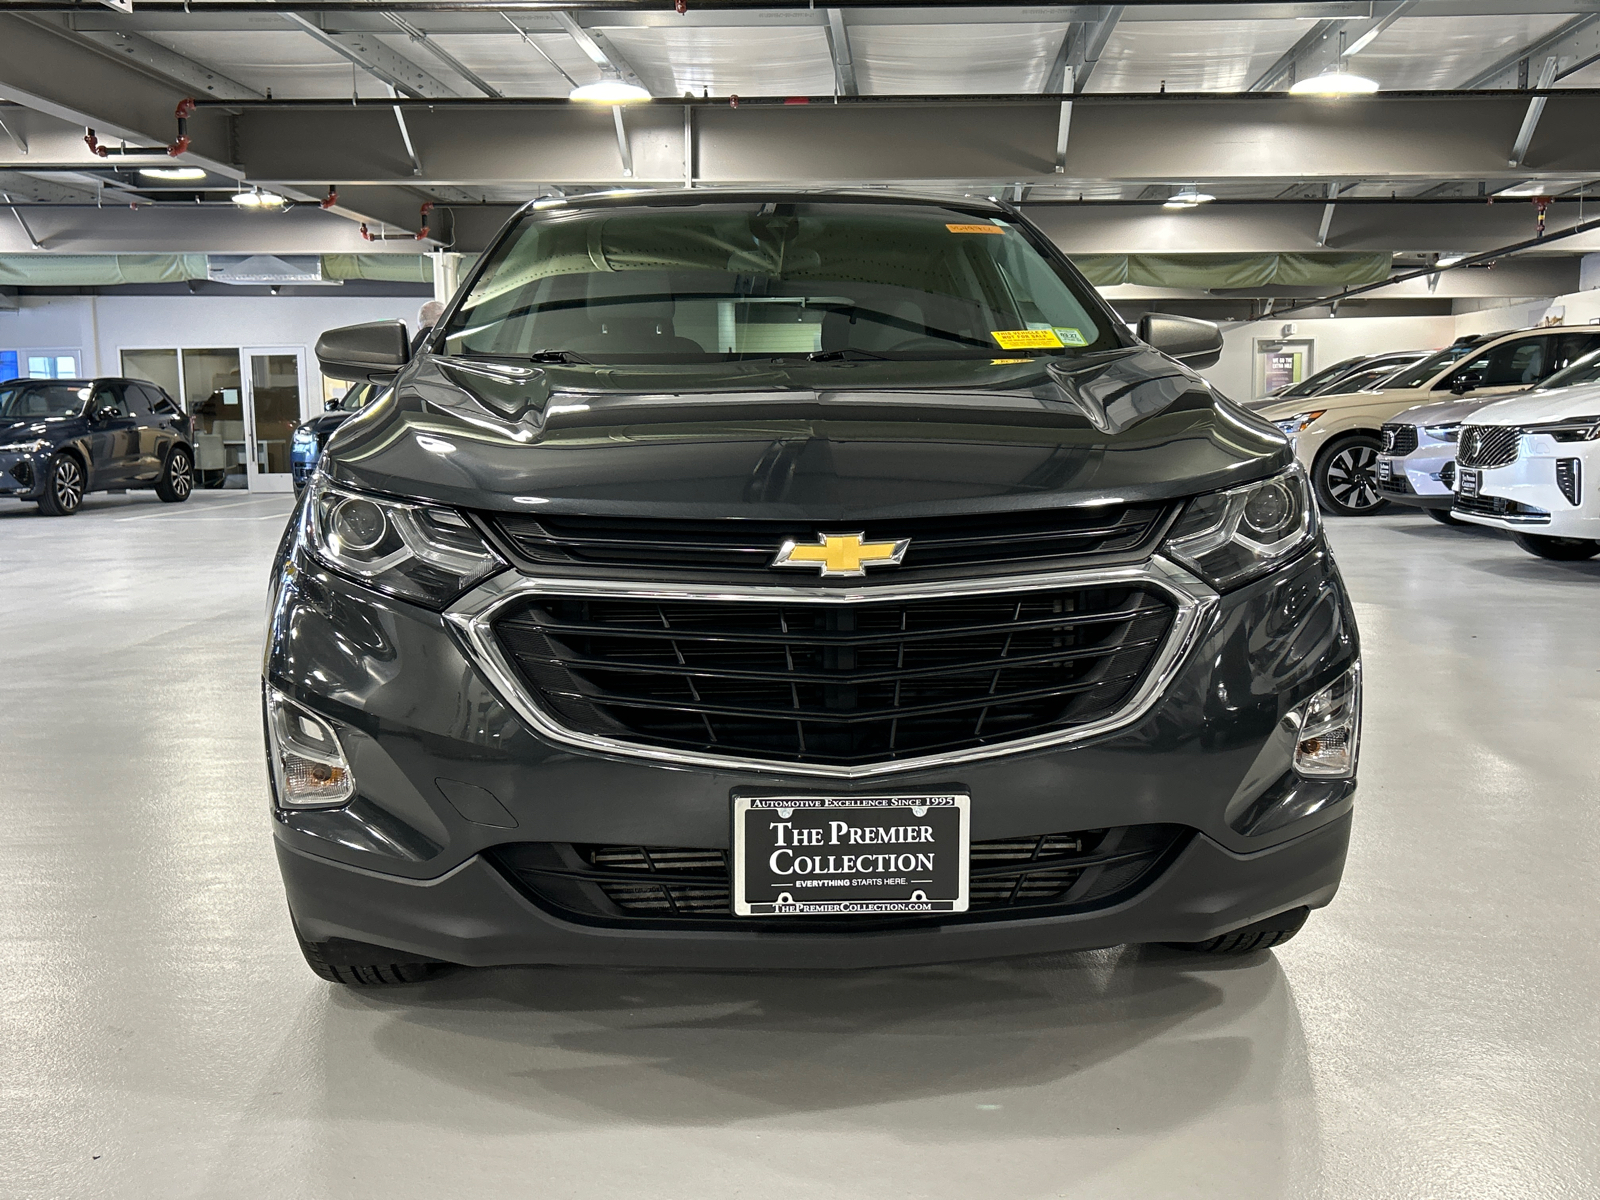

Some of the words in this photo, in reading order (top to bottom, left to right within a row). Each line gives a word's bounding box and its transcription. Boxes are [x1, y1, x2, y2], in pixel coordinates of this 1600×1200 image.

[752, 799, 822, 808] AUTOMOTIVE
[824, 798, 888, 807] EXCELLENCE
[891, 797, 922, 806] SINCE
[925, 797, 953, 806] 1995
[769, 821, 824, 847] THE
[828, 821, 935, 845] PREMIER
[769, 849, 935, 875] COLLECTION
[795, 880, 850, 888] EVERYTHING
[851, 878, 883, 886] STARTS
[883, 878, 908, 886] HERE.
